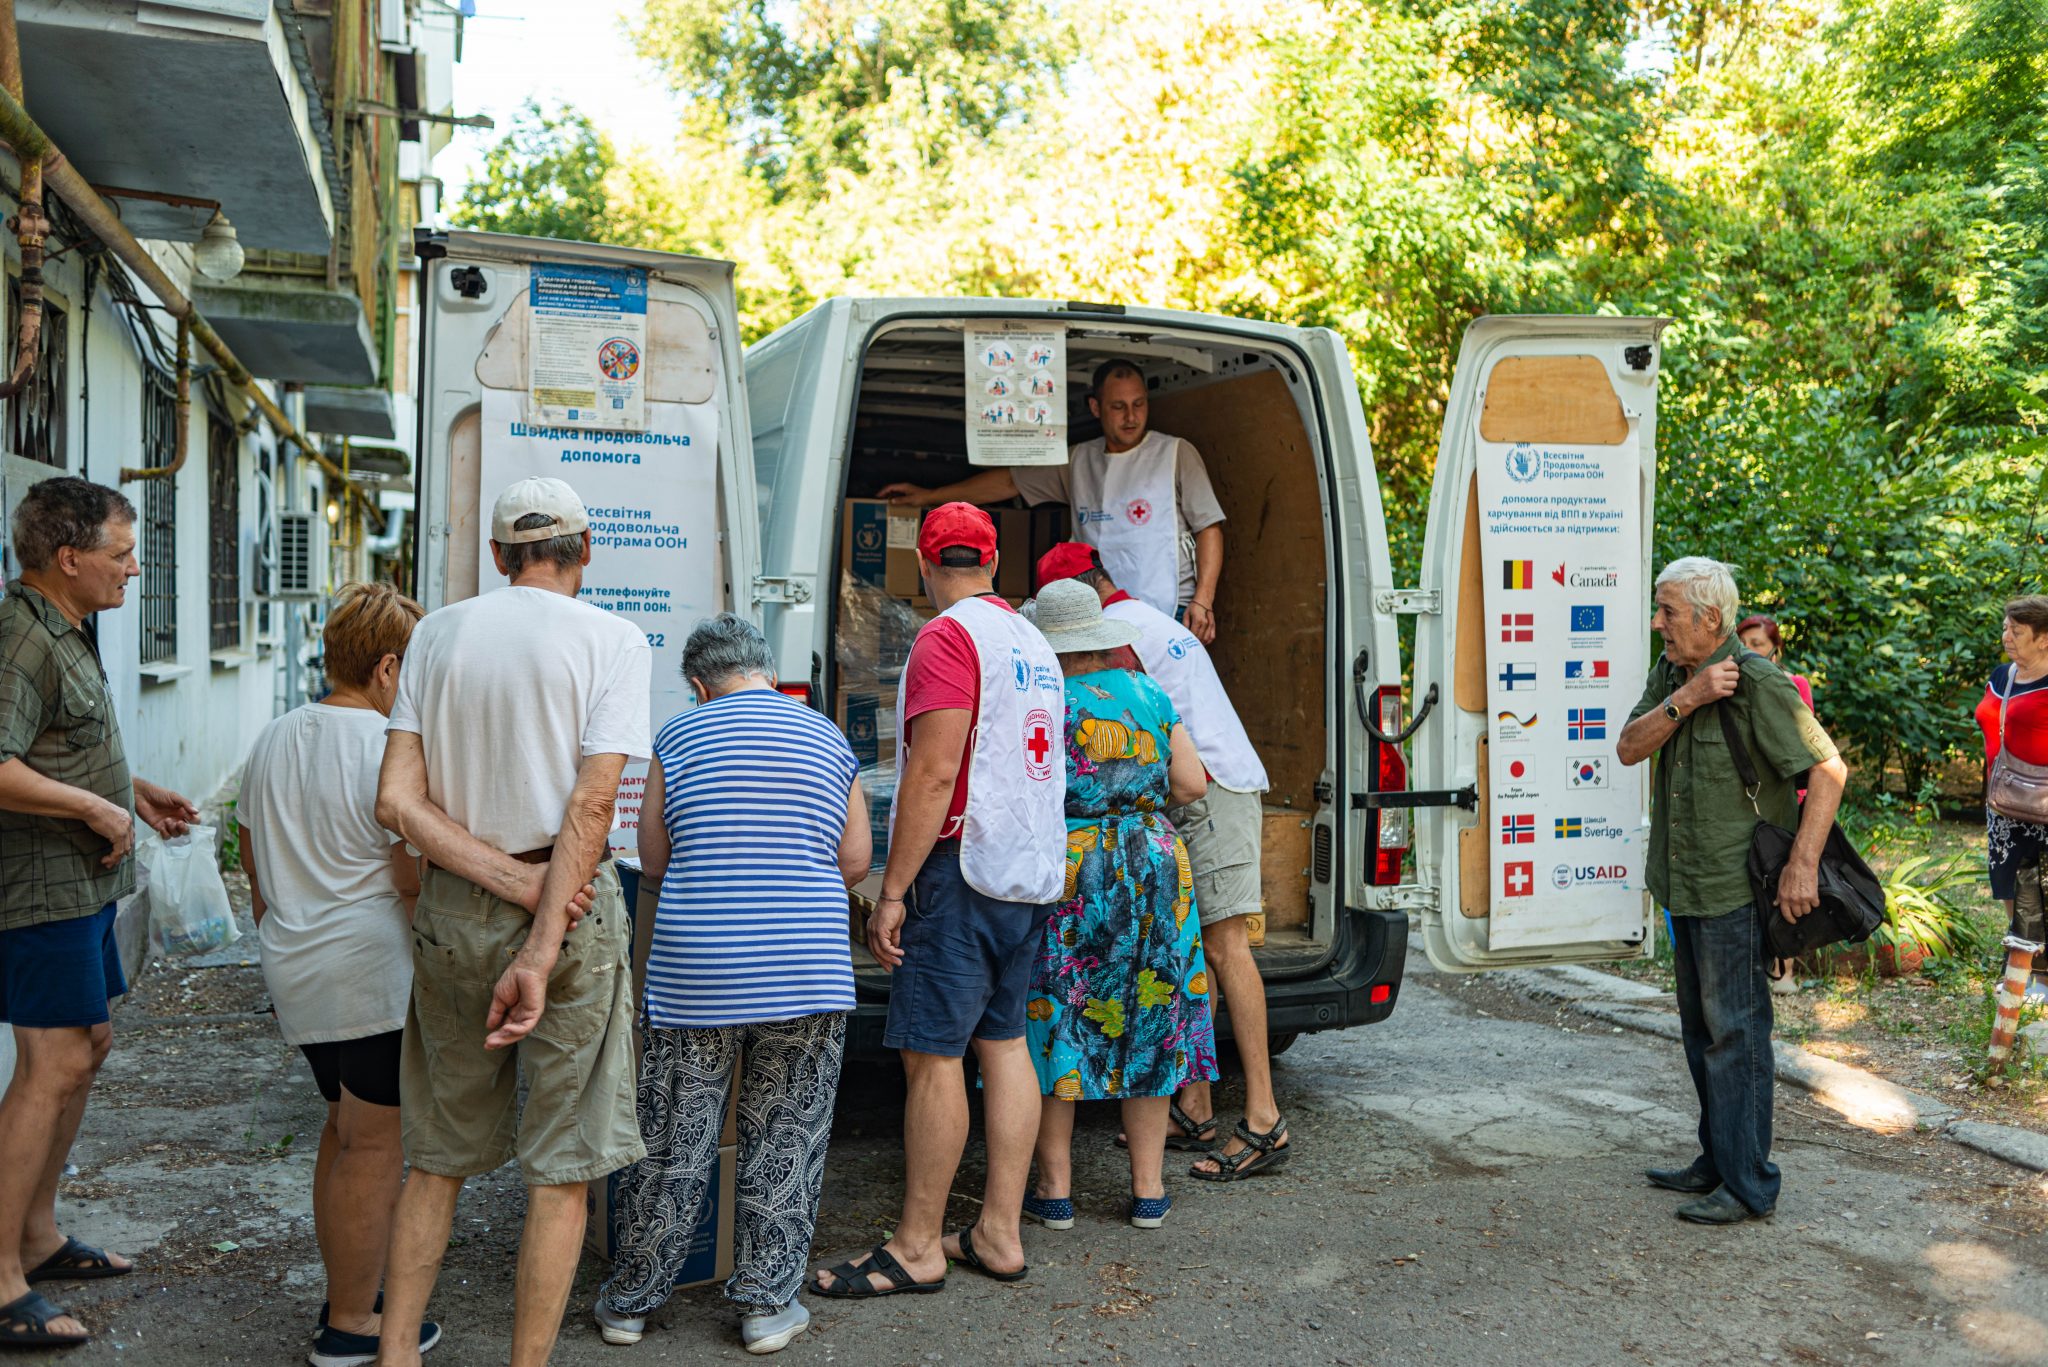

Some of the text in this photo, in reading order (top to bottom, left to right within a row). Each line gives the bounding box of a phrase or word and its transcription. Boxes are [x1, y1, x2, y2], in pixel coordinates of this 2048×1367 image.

[510, 422, 691, 447] Швидка продовольча
[560, 449, 641, 465] допомога
[1543, 451, 1585, 460] Всесвітня
[1543, 461, 1600, 470] Продовольча
[1543, 470, 1604, 480] Програма ООН
[1502, 496, 1606, 506] допомога продуктами
[584, 506, 651, 520] сесвітня
[1488, 510, 1542, 520] харчування
[1544, 510, 1558, 519] від
[1561, 510, 1580, 518] ВПП
[1589, 510, 1623, 520] Україні
[589, 522, 680, 535] родовольча
[1490, 524, 1552, 534] здійснюється
[590, 534, 688, 548] рограма ООН
[1570, 573, 1617, 588] Canada
[595, 586, 670, 599] телефонуйте
[616, 602, 640, 612] ВПП
[643, 602, 671, 612] ООН:
[1584, 825, 1623, 839] Sverige
[1575, 865, 1627, 880] USAID
